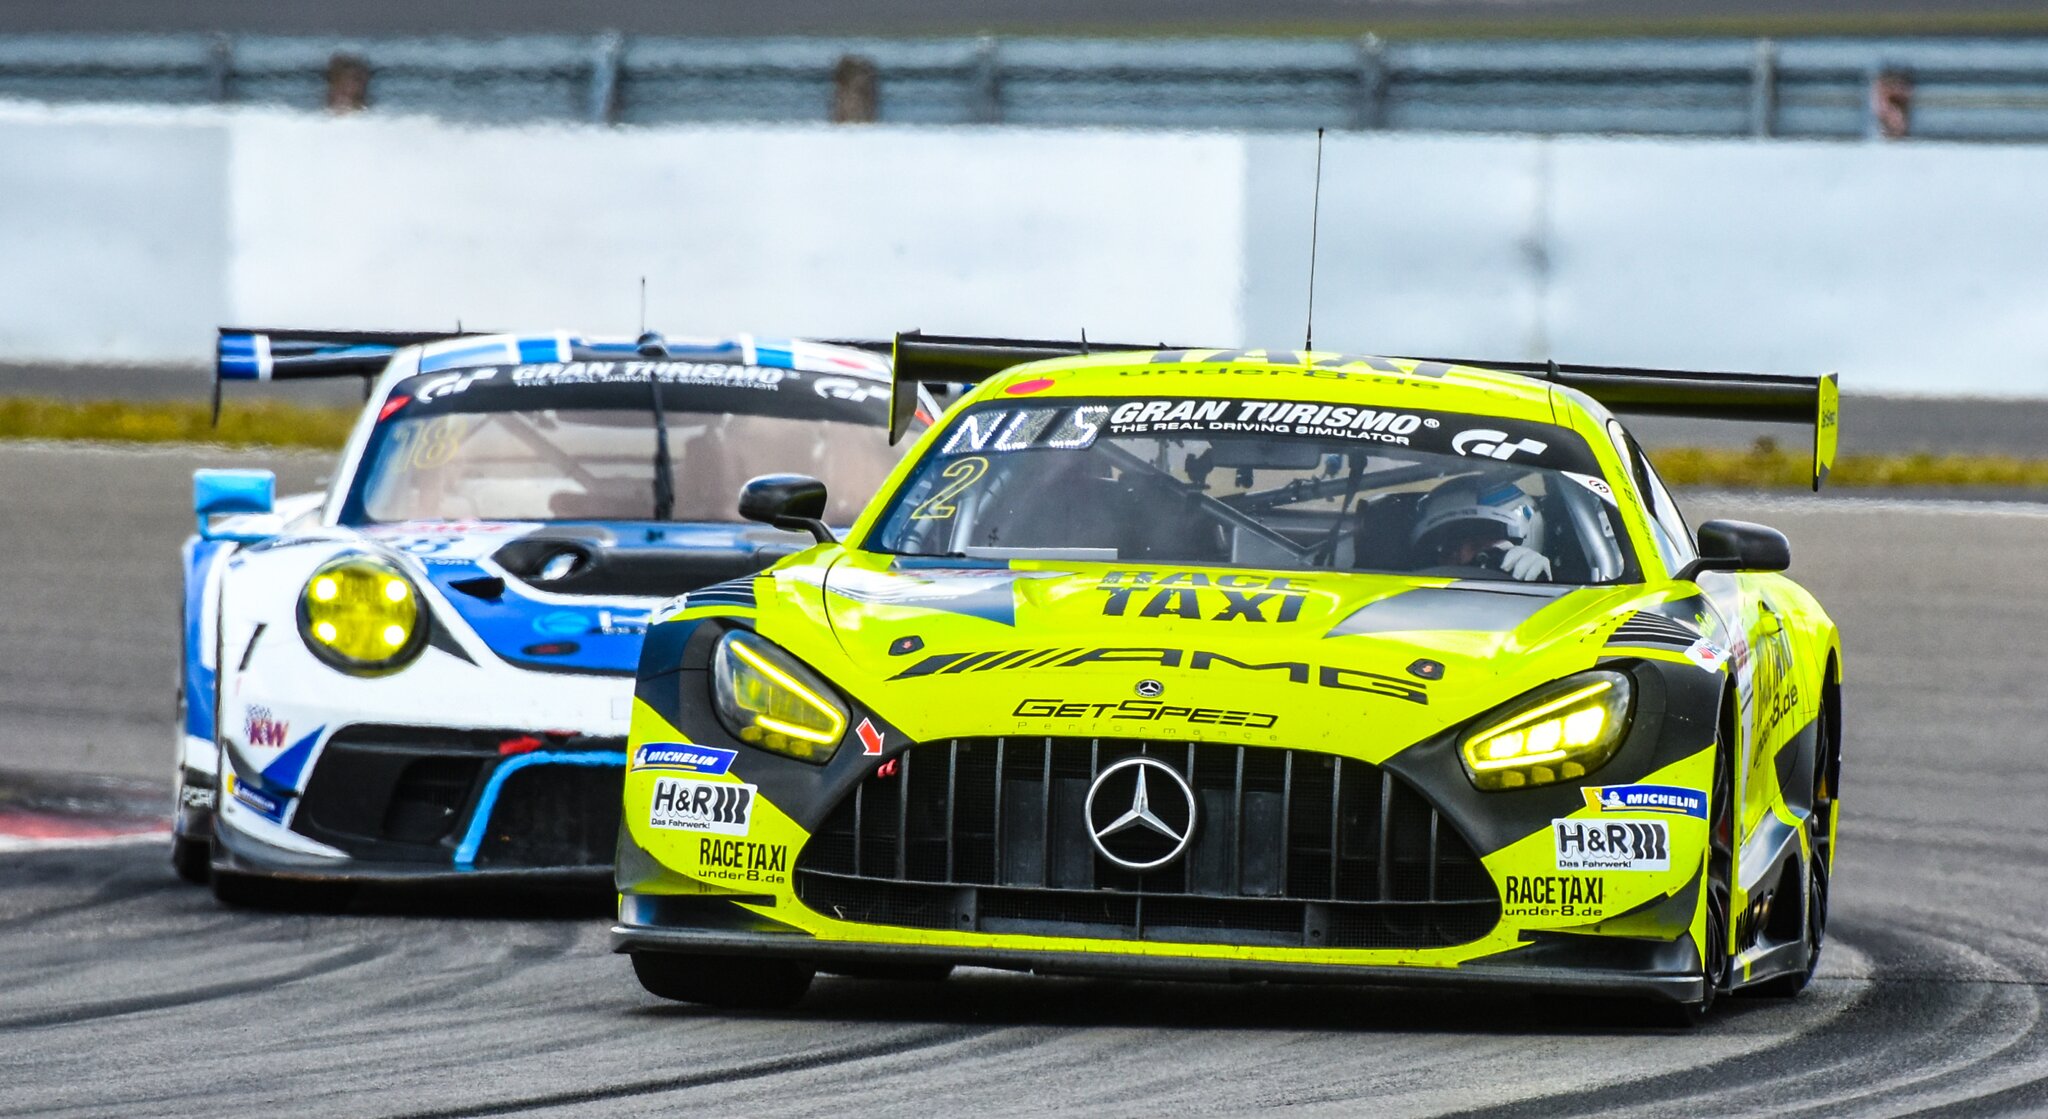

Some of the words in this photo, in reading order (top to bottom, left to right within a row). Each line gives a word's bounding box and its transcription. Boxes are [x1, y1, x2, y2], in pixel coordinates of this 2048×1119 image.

[1109, 400, 1231, 424] GRAN
[941, 405, 1109, 453] NLS
[1110, 424, 1148, 434] THE
[1153, 422, 1204, 431] REAL
[1209, 422, 1290, 434] DRIVING
[1295, 426, 1410, 447] SIMULATOR
[910, 456, 989, 519] 2
[1096, 587, 1307, 623] TAXI
[250, 720, 289, 748] KW
[647, 750, 719, 767] MICHELIN
[654, 781, 713, 817] H&R
[1626, 793, 1699, 809] MICHELIN
[651, 818, 666, 826] Das
[668, 819, 711, 829] Fahrwerk!
[1558, 823, 1629, 854] H&R
[698, 868, 785, 884] under8.de
[1559, 860, 1579, 868] Das
[1582, 860, 1632, 868] Fahrwerk!
[1504, 905, 1603, 917] under8.de
